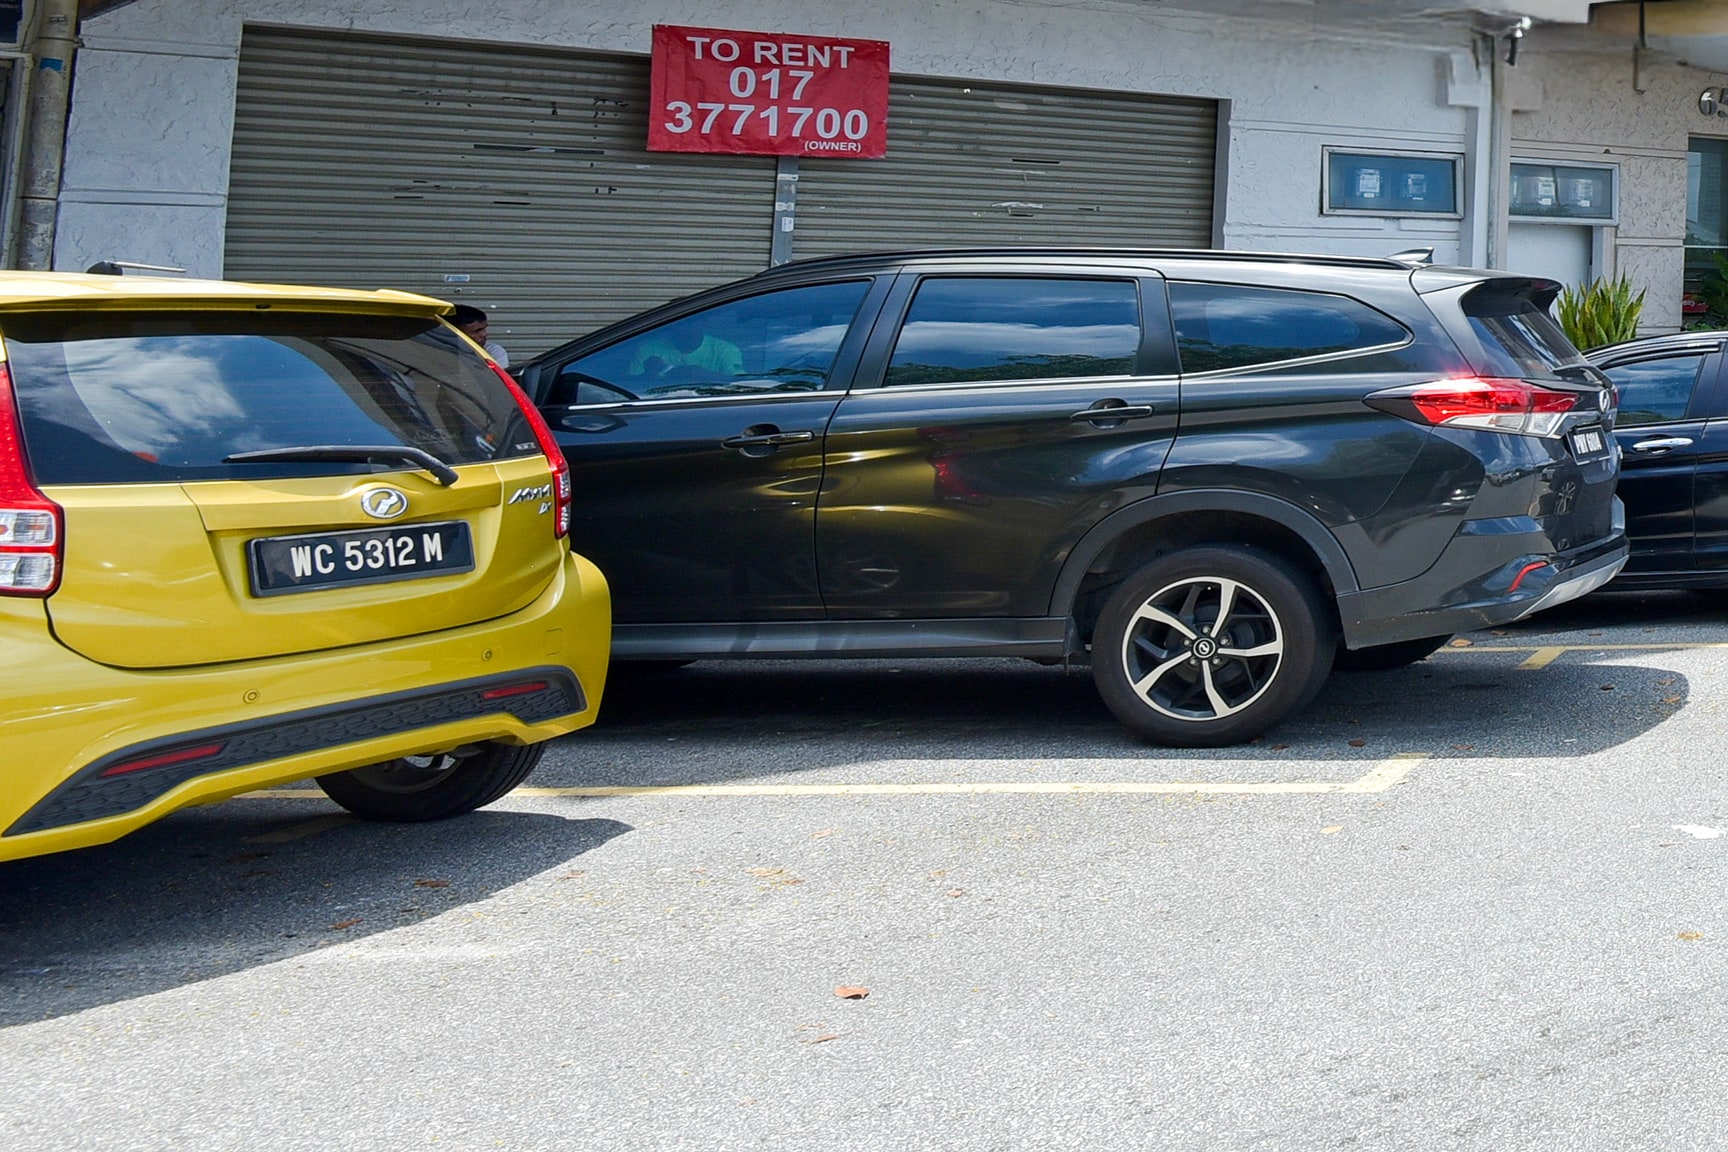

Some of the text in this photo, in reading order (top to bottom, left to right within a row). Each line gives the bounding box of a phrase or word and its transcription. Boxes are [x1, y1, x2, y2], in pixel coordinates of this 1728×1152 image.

[687, 36, 855, 68] TO RENT
[729, 66, 814, 101] 017
[664, 101, 868, 140] 3771700
[804, 140, 861, 153] (OWNER)
[290, 532, 443, 577] WC 5312 M
